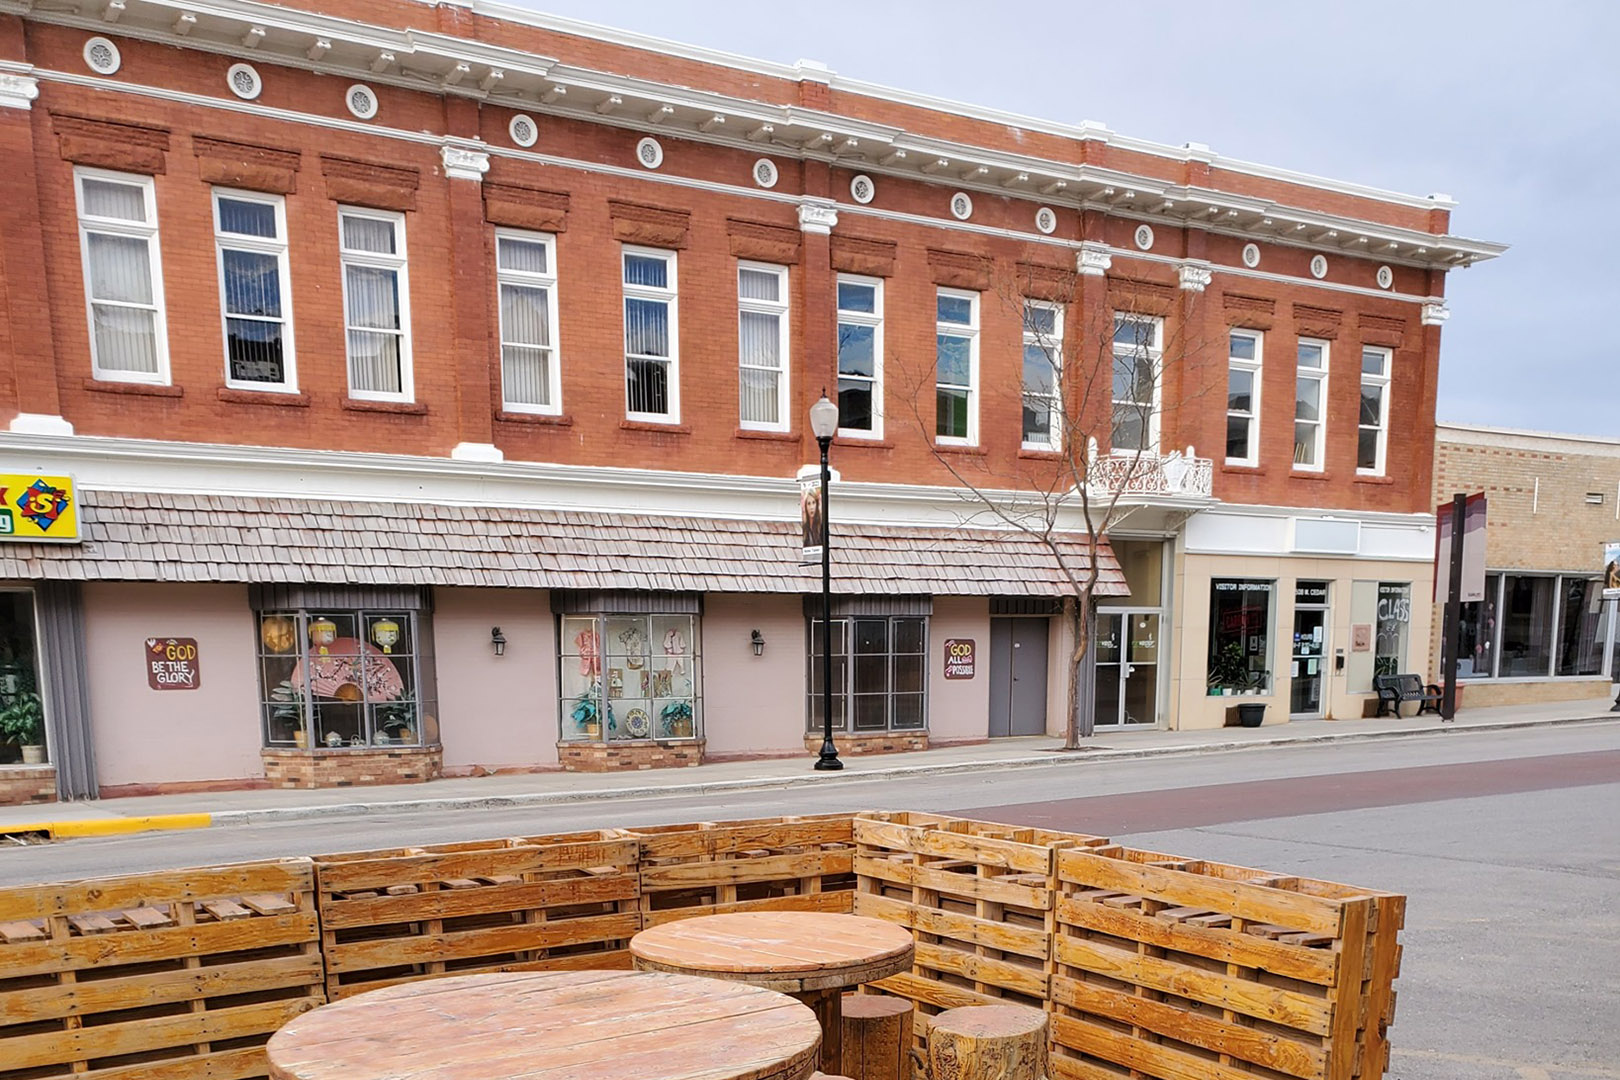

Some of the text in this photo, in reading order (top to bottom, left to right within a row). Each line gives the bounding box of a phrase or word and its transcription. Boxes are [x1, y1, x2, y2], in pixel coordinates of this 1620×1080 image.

[1378, 598, 1410, 623] CLASS
[166, 644, 196, 660] GOD
[950, 644, 972, 656] GOD
[152, 661, 189, 673] BE THE
[156, 669, 195, 684] GLORY
